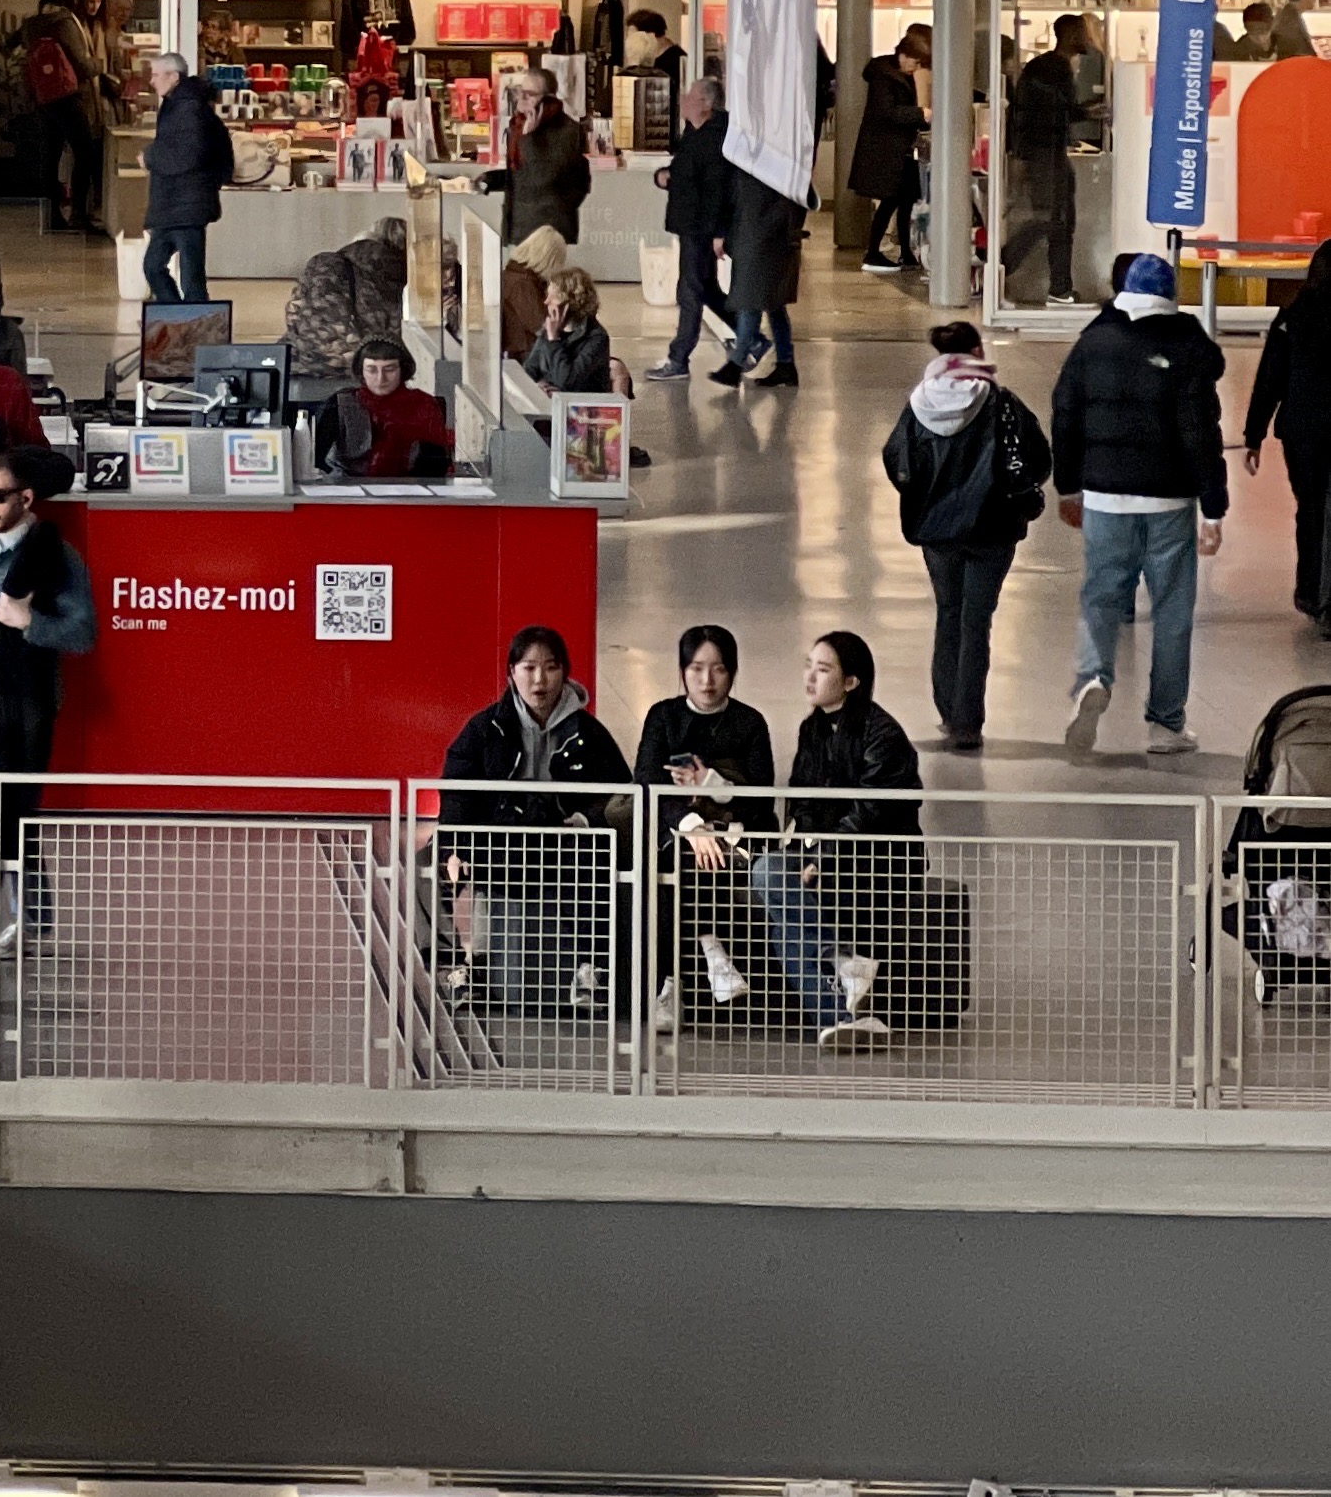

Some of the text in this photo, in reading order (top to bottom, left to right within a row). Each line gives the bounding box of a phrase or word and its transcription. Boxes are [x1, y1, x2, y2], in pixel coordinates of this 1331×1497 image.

[1179, 28, 1205, 133] Expositions
[1173, 148, 1197, 211] Musée
[112, 577, 295, 611] Flashez-moi
[112, 615, 167, 630] Scan me
